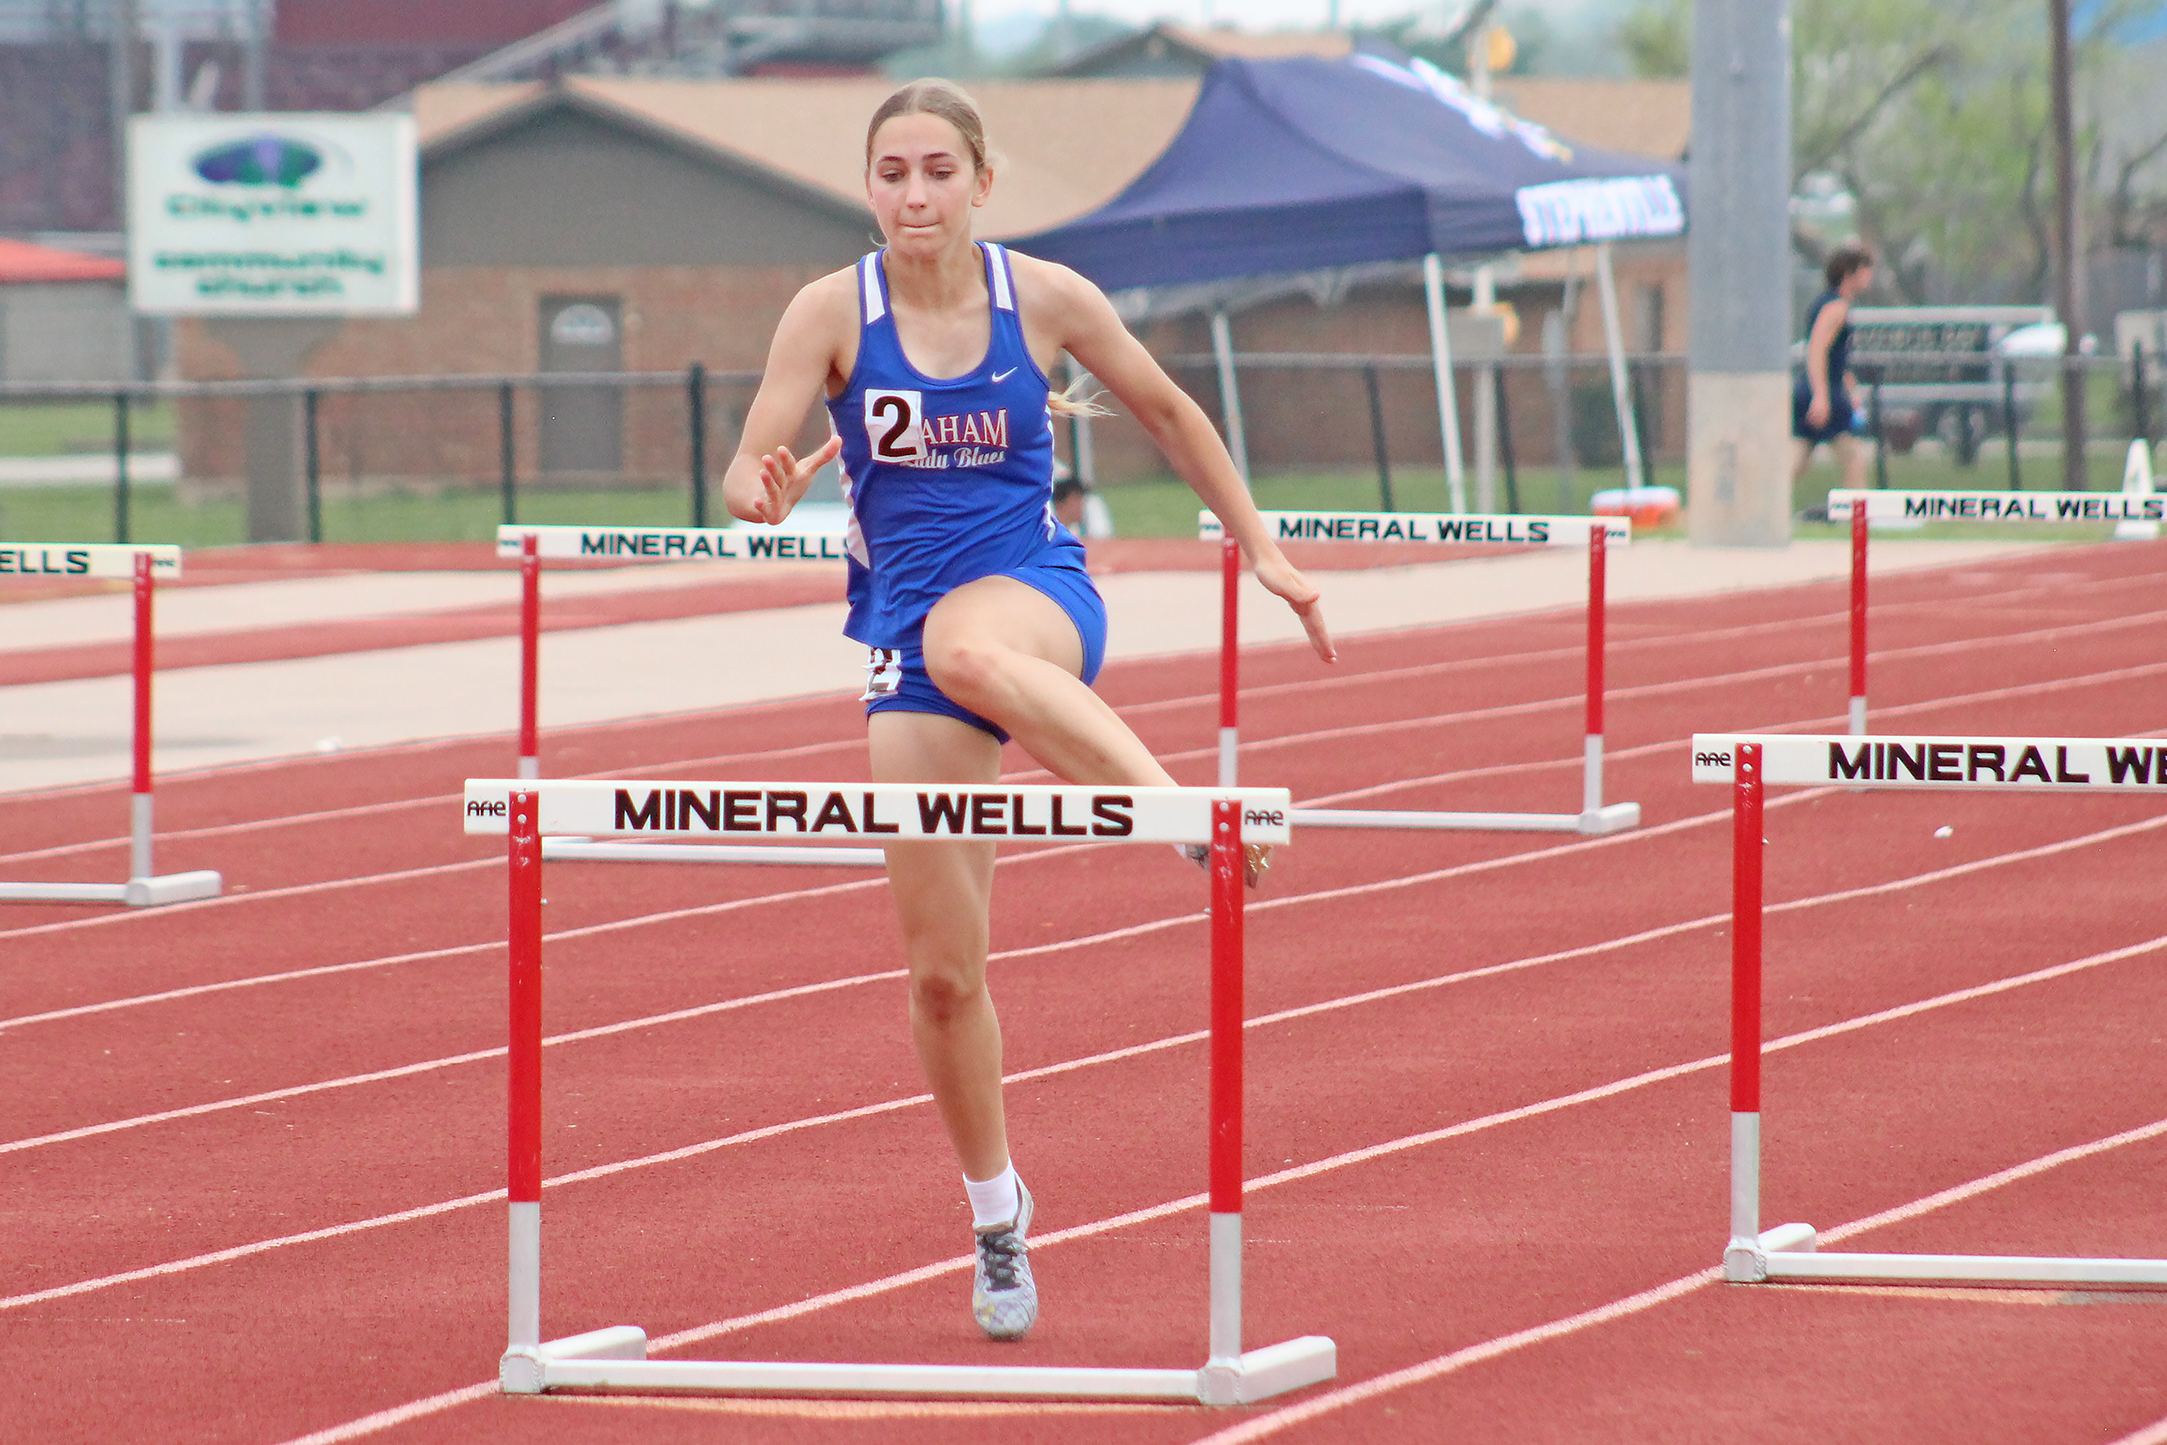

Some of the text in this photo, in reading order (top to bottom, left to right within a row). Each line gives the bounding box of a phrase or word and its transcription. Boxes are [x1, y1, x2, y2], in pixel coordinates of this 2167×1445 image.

[872, 396, 917, 457] 2
[921, 408, 1009, 448] AHAM
[953, 446, 1006, 468] Blues
[1905, 497, 2164, 519] MINERAL WELLS
[1279, 518, 1550, 542] MINERAL WELLS
[581, 533, 737, 557] MINERAL
[0, 550, 90, 575] ELLS
[1828, 742, 2090, 783] MINERAL
[614, 789, 1134, 836] MINERAL WELLS
